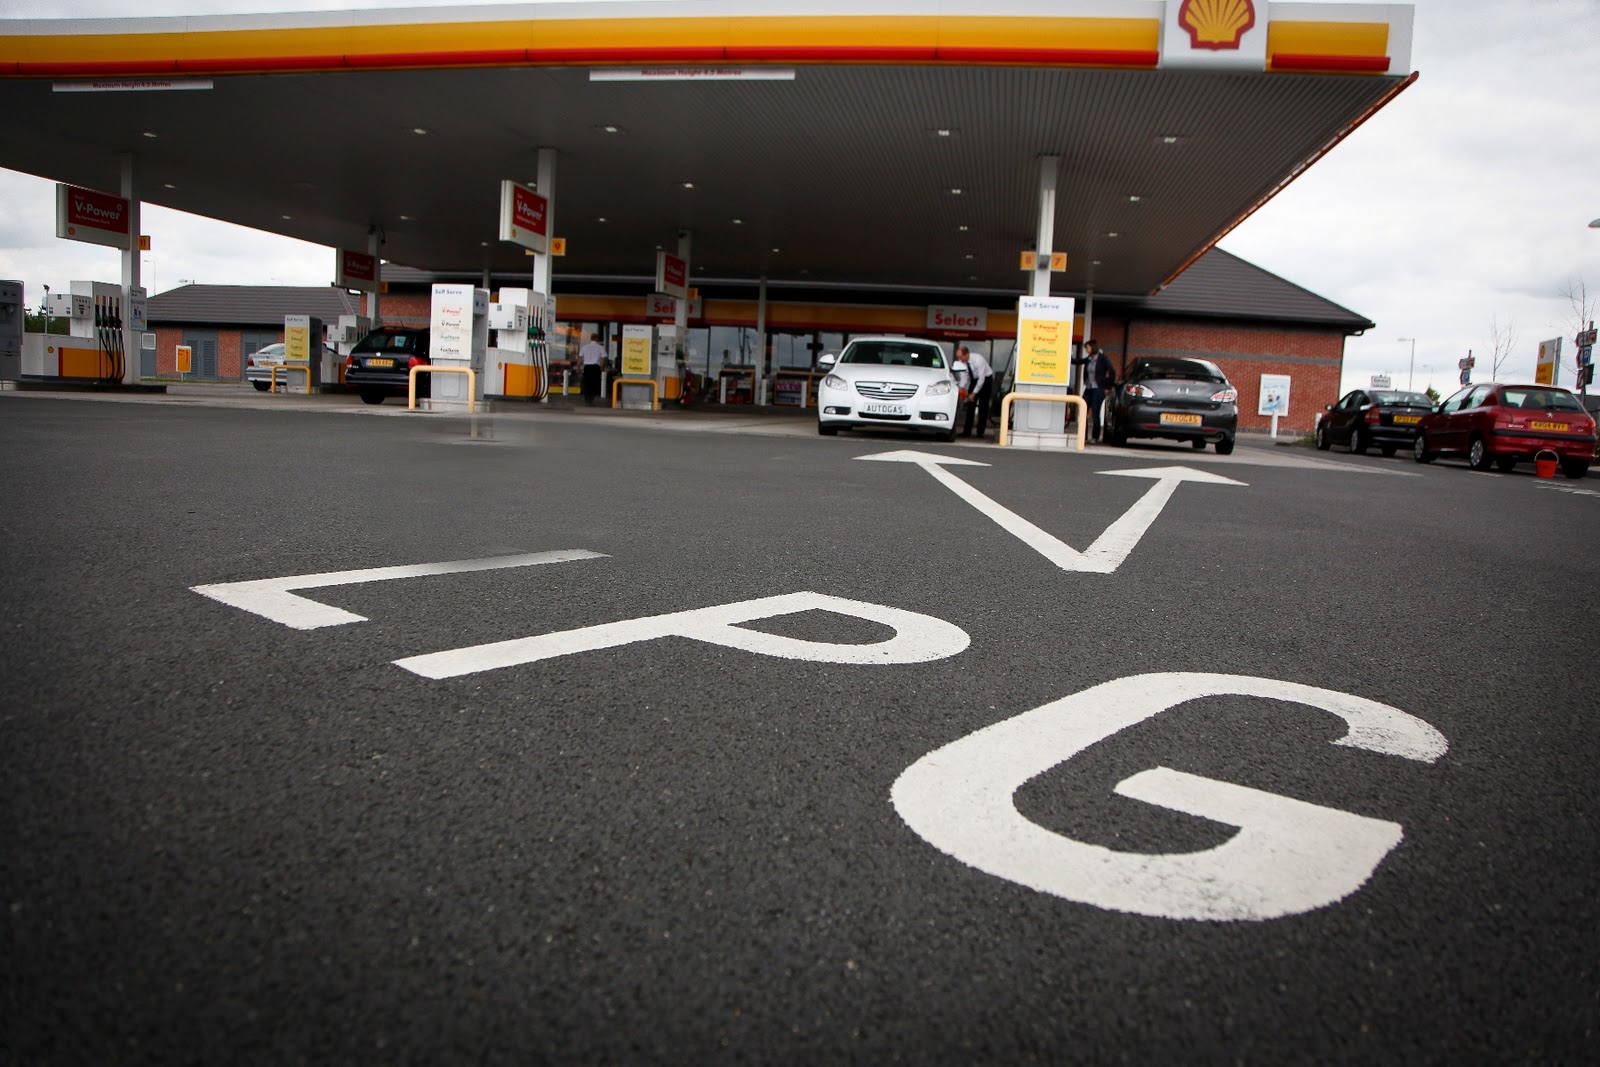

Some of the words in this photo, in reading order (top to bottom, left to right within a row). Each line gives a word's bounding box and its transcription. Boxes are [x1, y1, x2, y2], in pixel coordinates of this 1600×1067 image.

[74, 200, 121, 220] V-Power
[516, 199, 542, 220] V-Power
[935, 312, 979, 327] Select
[866, 404, 903, 414] AUTOGAS
[1164, 414, 1198, 423] AUTOGAS
[189, 549, 1449, 922] LPG
